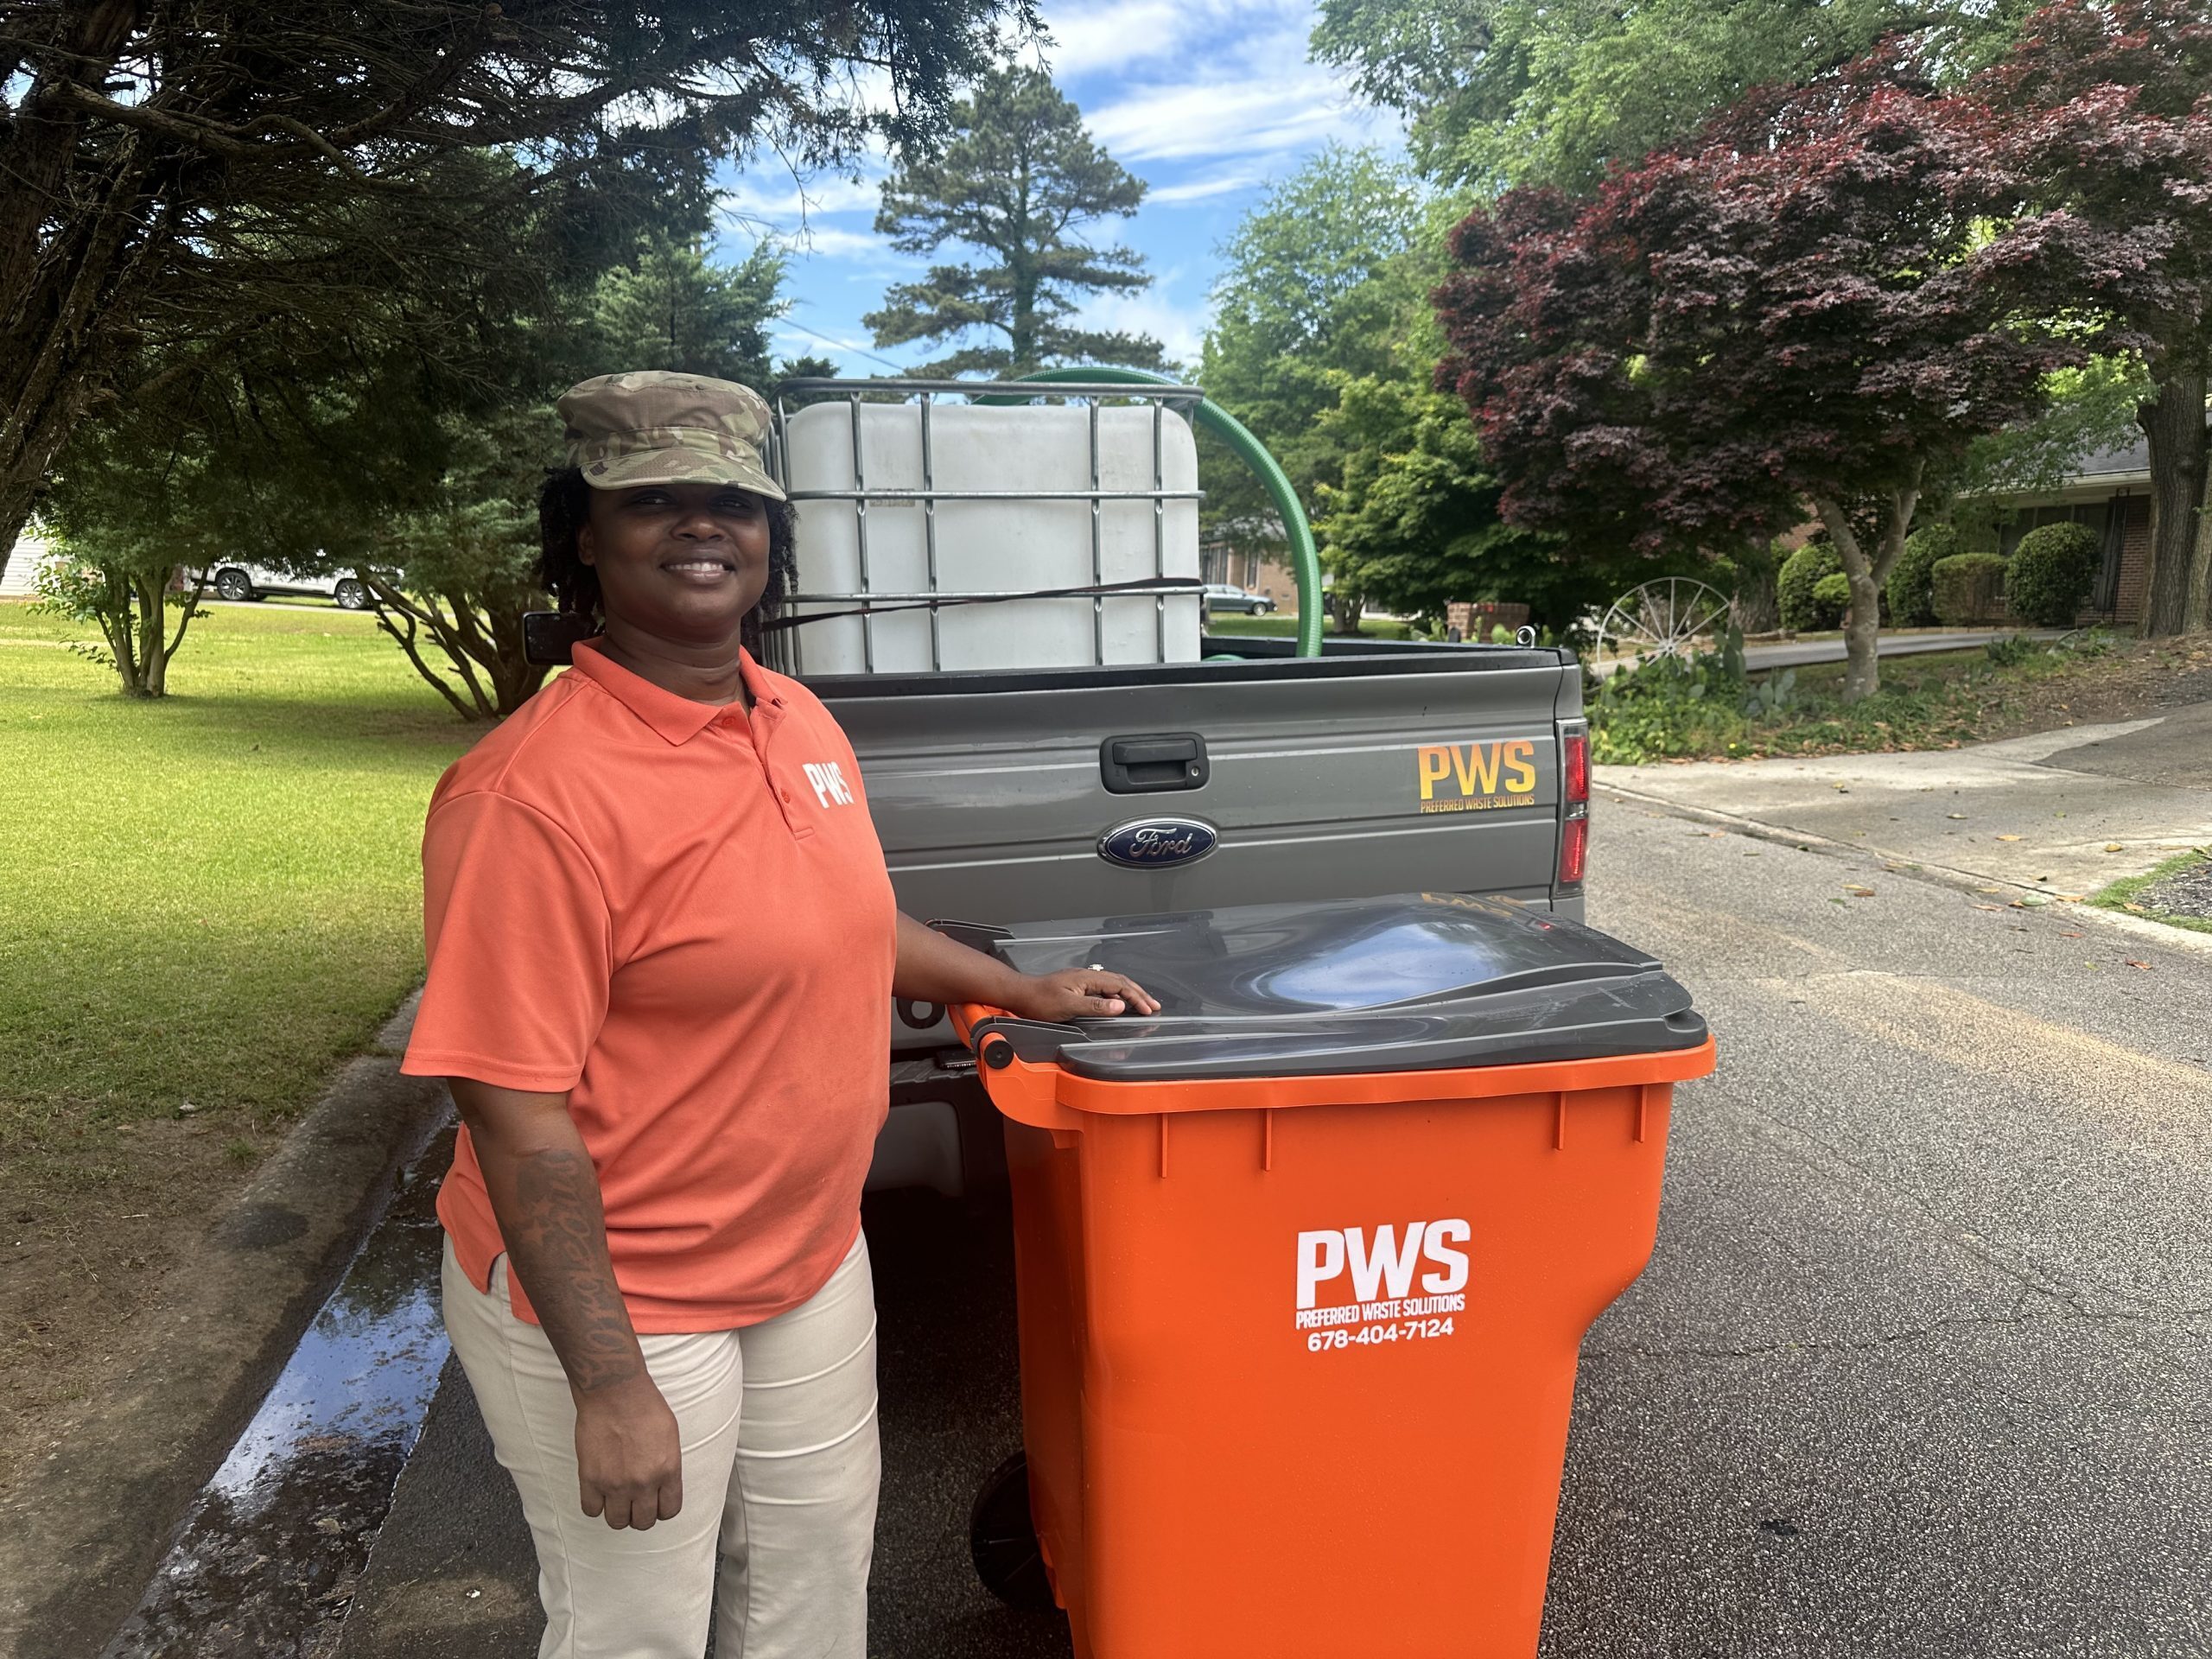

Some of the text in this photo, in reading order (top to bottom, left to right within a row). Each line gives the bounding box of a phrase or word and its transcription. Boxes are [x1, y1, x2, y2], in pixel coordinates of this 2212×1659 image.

[802, 761, 855, 809] PWS
[1418, 741, 1535, 799] PWS
[1421, 793, 1535, 813] PREFERRED WASTE SOLUTIONS
[1128, 828, 1193, 858] Ford
[1296, 1218, 1471, 1310] PWS
[1296, 1294, 1465, 1330] PREFERRED WASTE SOLUTIONS
[1307, 1317, 1454, 1351] 678-404-7124
